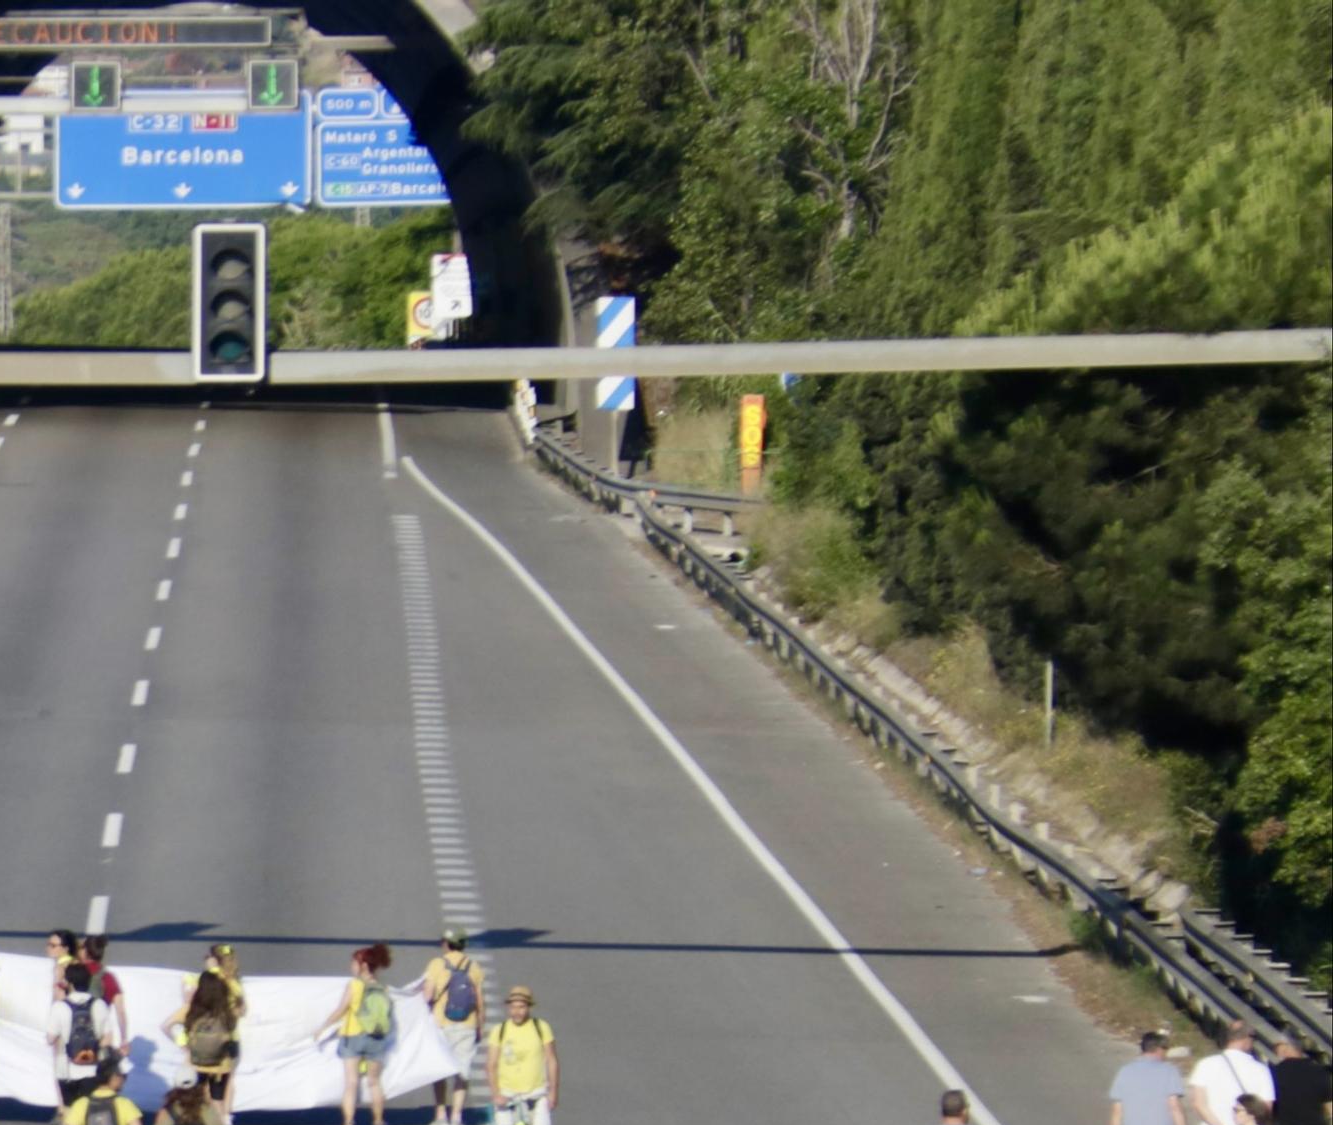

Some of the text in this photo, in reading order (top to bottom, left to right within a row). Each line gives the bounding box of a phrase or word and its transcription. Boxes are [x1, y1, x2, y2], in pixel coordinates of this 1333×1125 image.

[326, 98, 371, 110] 500 m
[132, 113, 179, 128] C-32
[325, 130, 377, 143] Mataró
[122, 145, 244, 165] Barcelona
